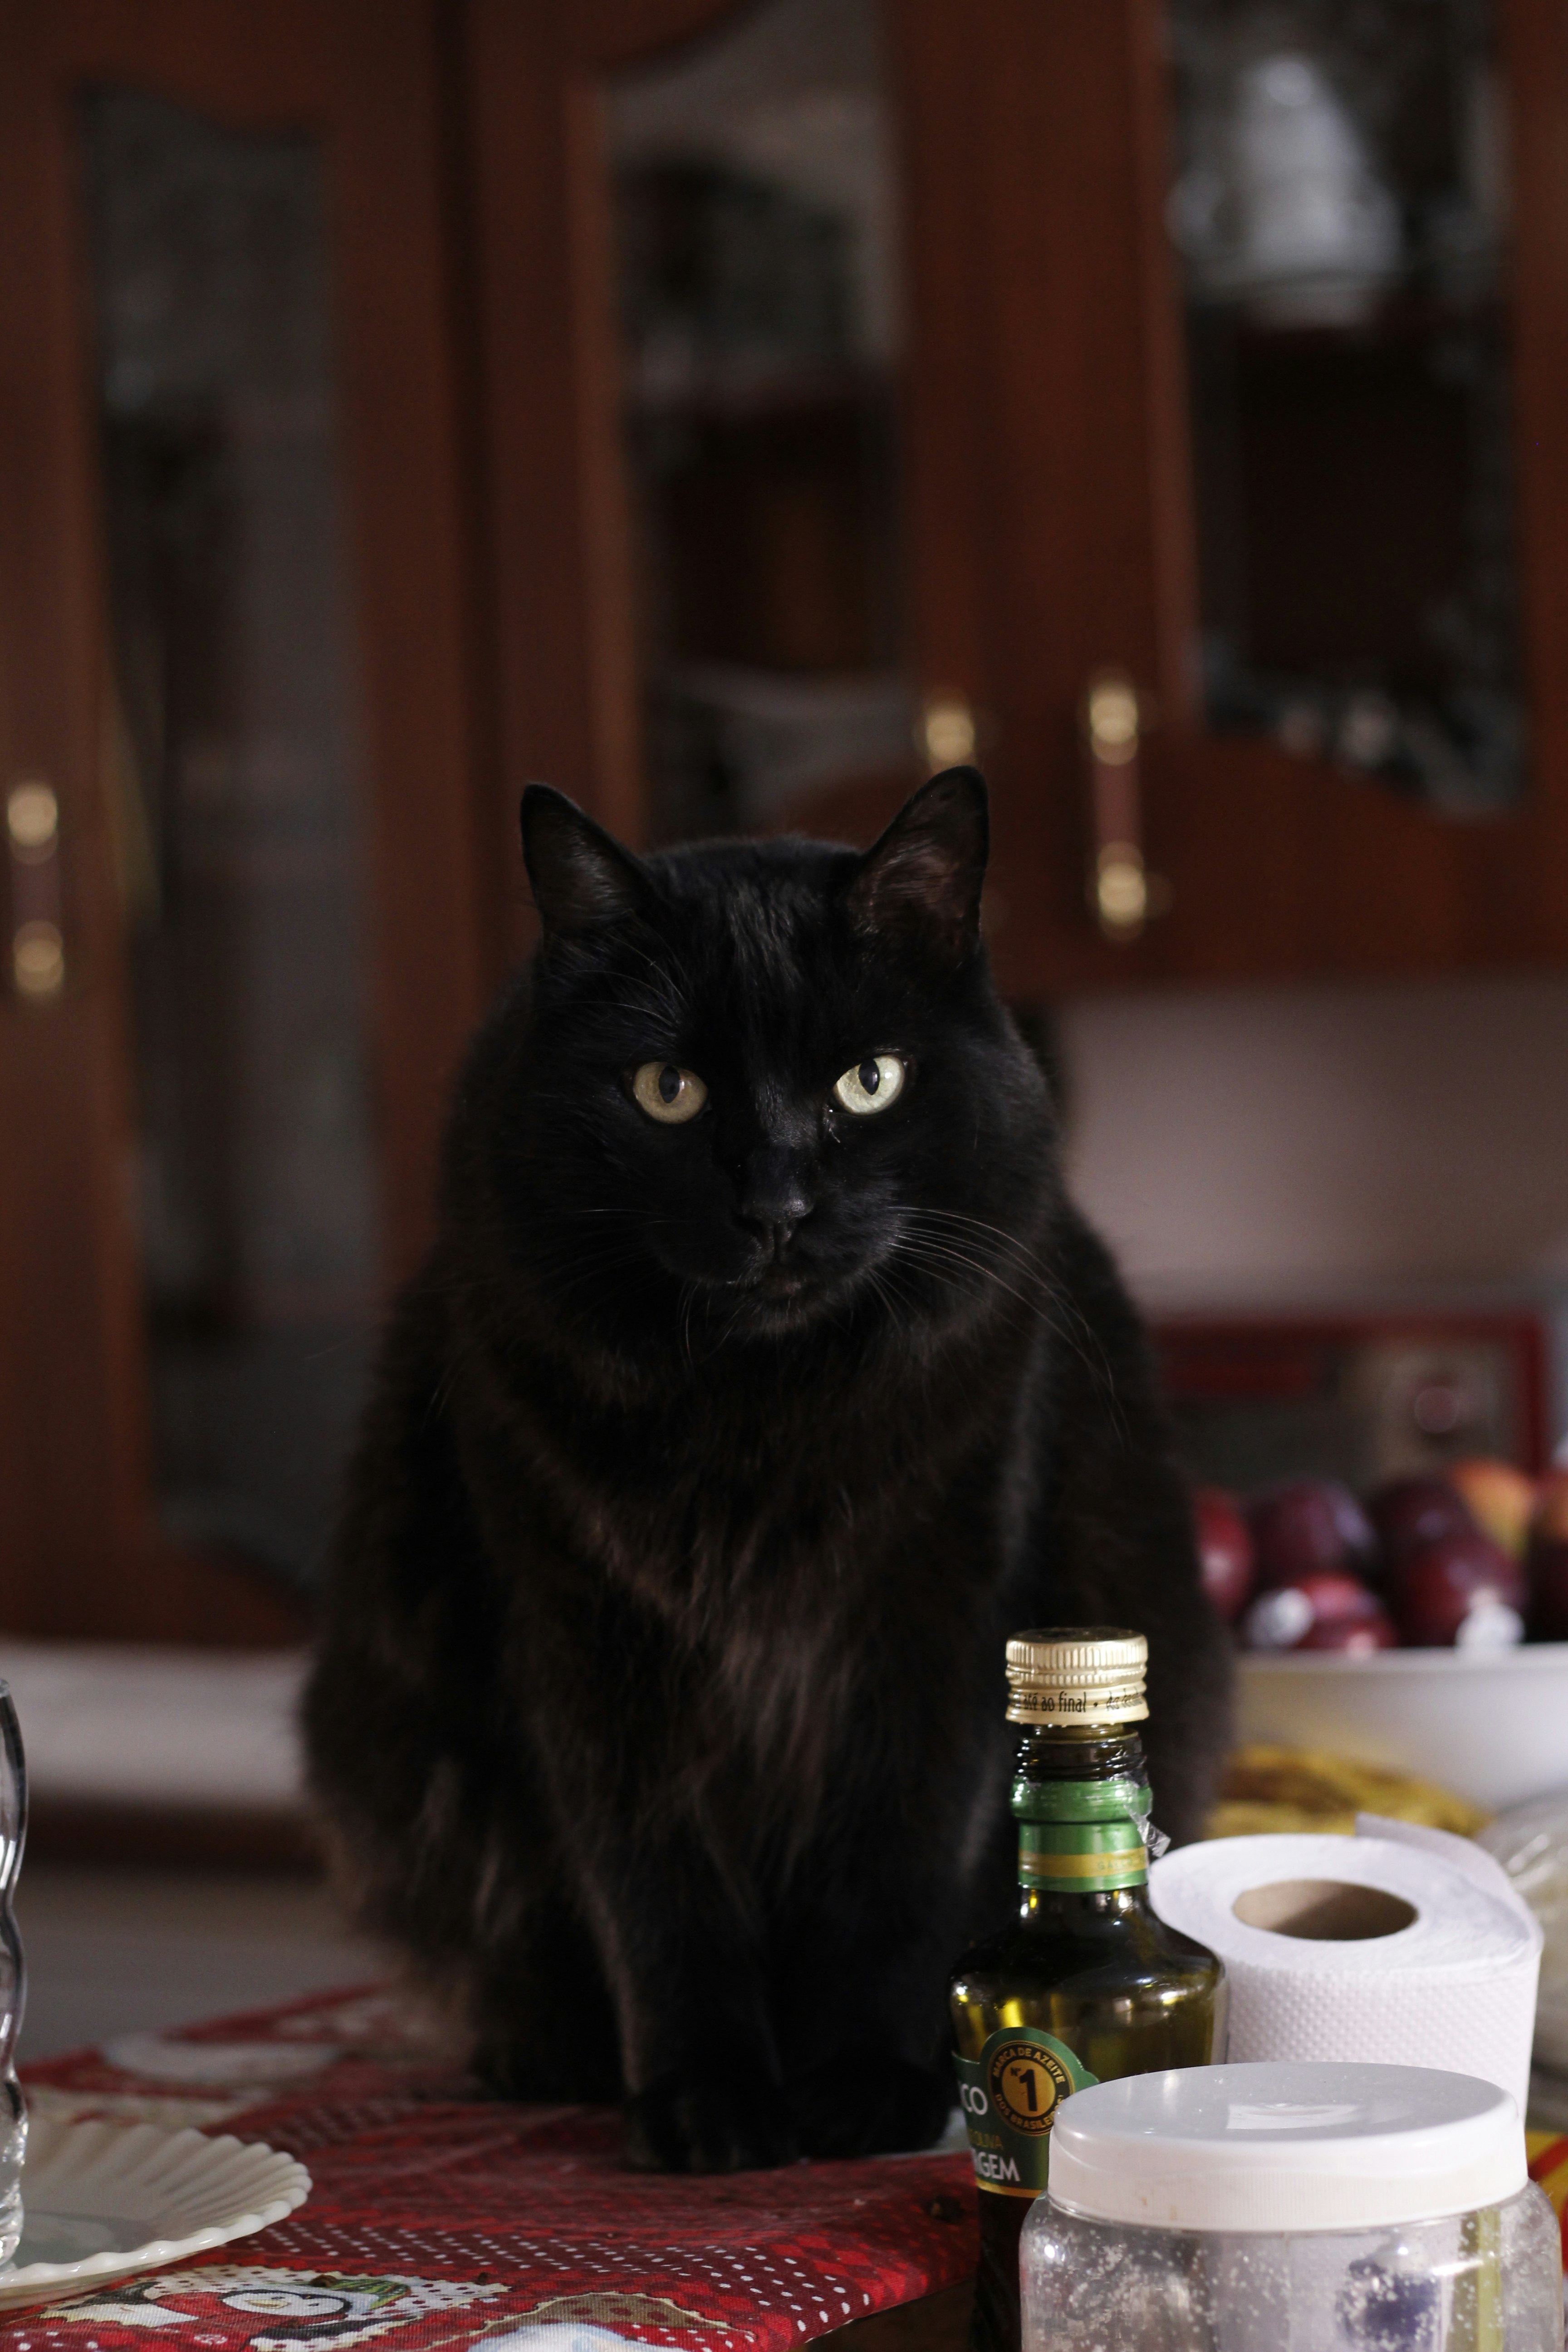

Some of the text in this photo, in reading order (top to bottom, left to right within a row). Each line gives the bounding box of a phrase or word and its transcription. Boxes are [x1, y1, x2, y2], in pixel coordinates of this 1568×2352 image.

[1024, 1692, 1038, 1710] até
[1041, 1696, 1055, 1711] ao
[1058, 1690, 1087, 1713] final
[993, 2047, 1066, 2084] MARCA DE AZEITE
[995, 2093, 1011, 2116] DOS
[1020, 2069, 1037, 2112] 1
